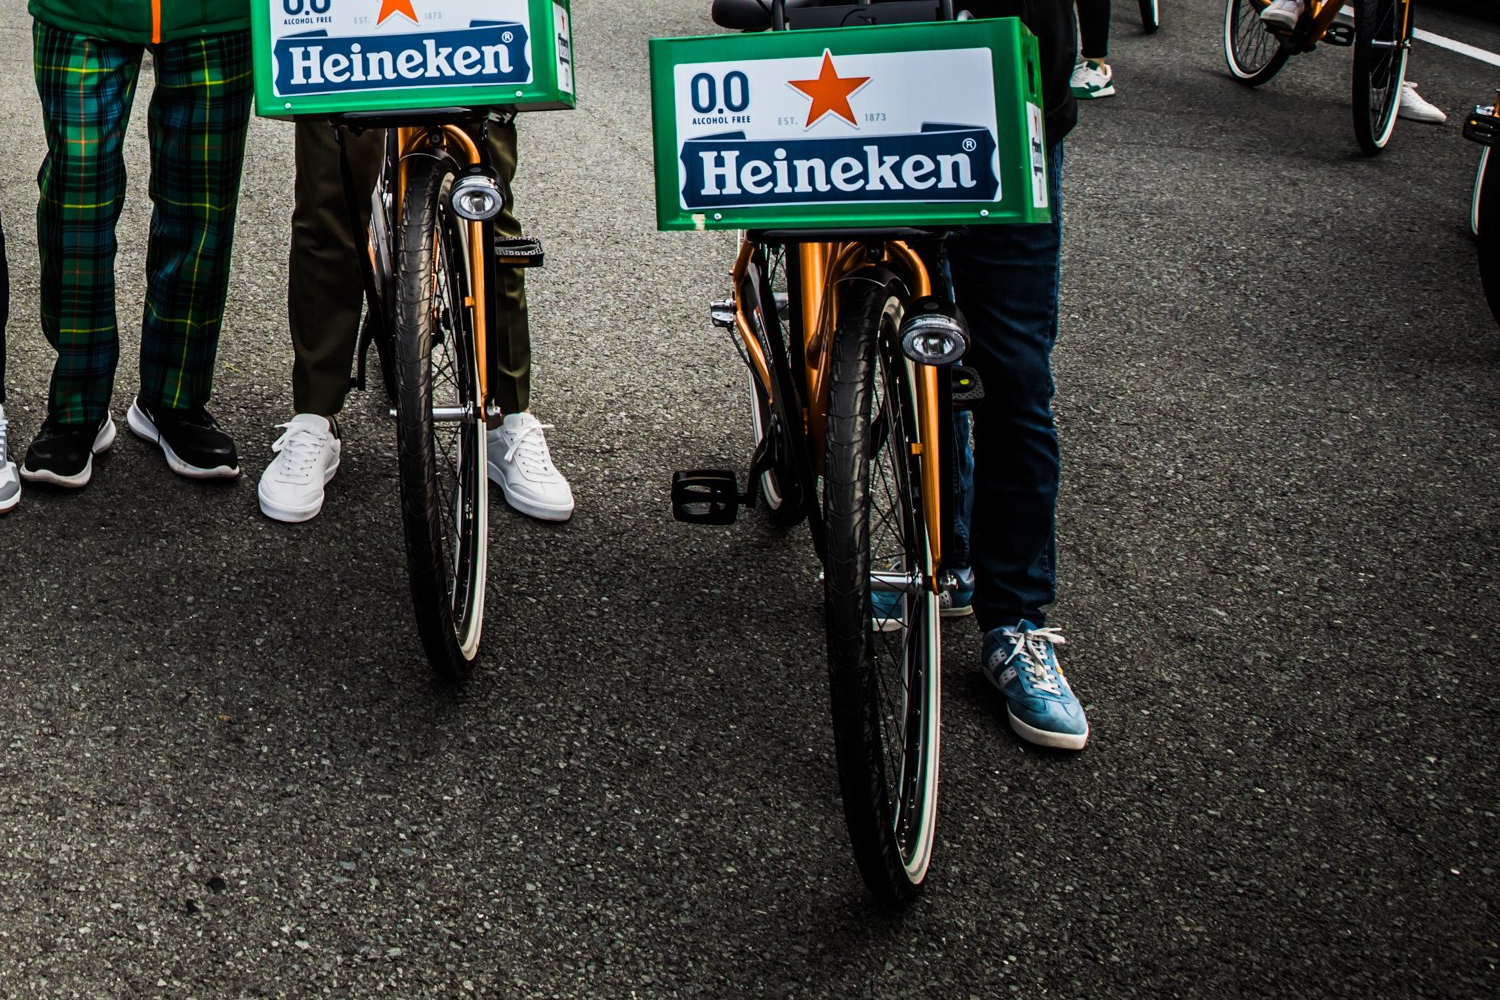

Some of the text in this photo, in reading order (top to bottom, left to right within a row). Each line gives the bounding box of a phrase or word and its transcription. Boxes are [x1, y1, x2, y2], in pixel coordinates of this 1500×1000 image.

[283, 16, 332, 26] ALCOHOL FREE
[353, 12, 442, 25] EST. 1873
[690, 70, 750, 114] 0.0
[692, 115, 751, 125] ALCOHOL FREE
[778, 112, 887, 126] EST. 1873
